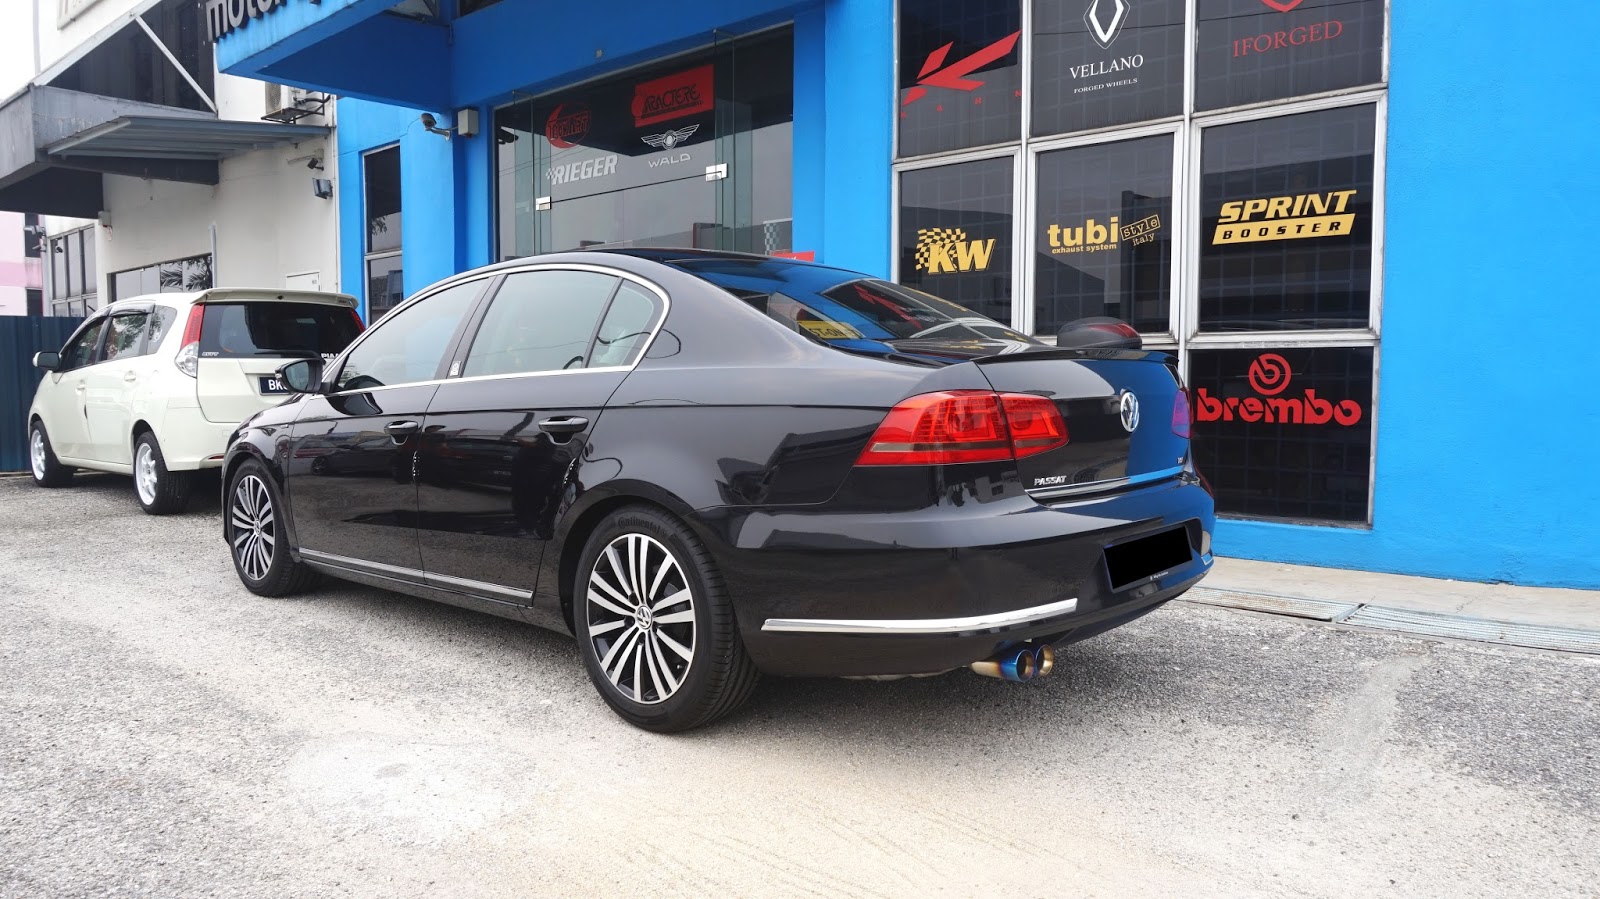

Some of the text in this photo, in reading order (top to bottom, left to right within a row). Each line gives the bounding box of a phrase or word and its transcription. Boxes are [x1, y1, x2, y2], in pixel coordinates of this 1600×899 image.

[1232, 19, 1343, 58] IFORGED
[1069, 54, 1144, 79] VELLANO
[1073, 77, 1138, 94] FORGED WHEELS
[551, 154, 618, 186] RIEGER
[648, 153, 691, 168] WALD
[1218, 189, 1357, 223] SPRINT
[1047, 216, 1158, 247] tubi style
[1132, 233, 1155, 247] italy
[1222, 221, 1341, 240] BOOSTER
[928, 238, 996, 275] KW
[1052, 243, 1117, 254] exhaust system
[268, 379, 288, 391] BK
[1197, 387, 1362, 426] brembo
[1034, 475, 1067, 486] PASSAT
